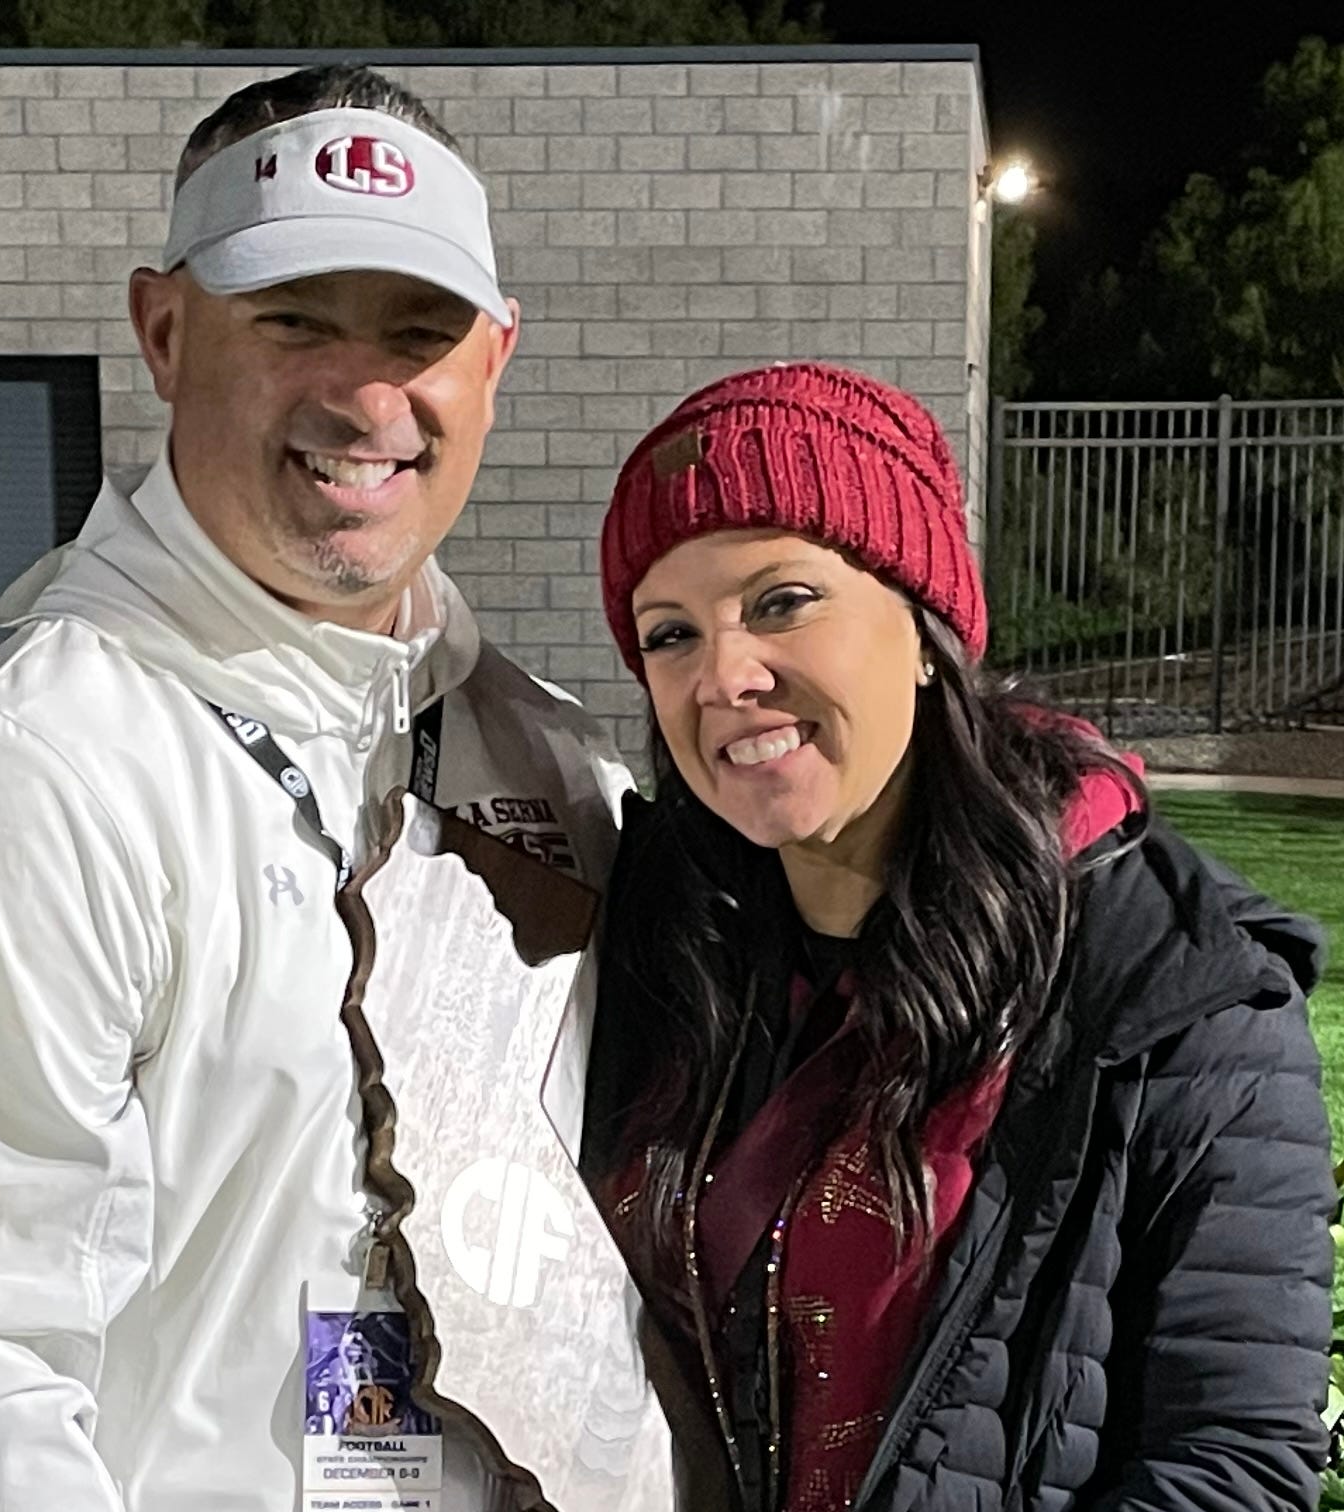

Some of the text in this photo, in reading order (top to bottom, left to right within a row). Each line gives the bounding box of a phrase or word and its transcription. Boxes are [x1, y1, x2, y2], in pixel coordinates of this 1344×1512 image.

[326, 137, 407, 193] LS
[440, 1155, 577, 1309] CIF
[338, 1440, 407, 1452] FOOTBALL
[323, 1467, 396, 1479] DECEMBER
